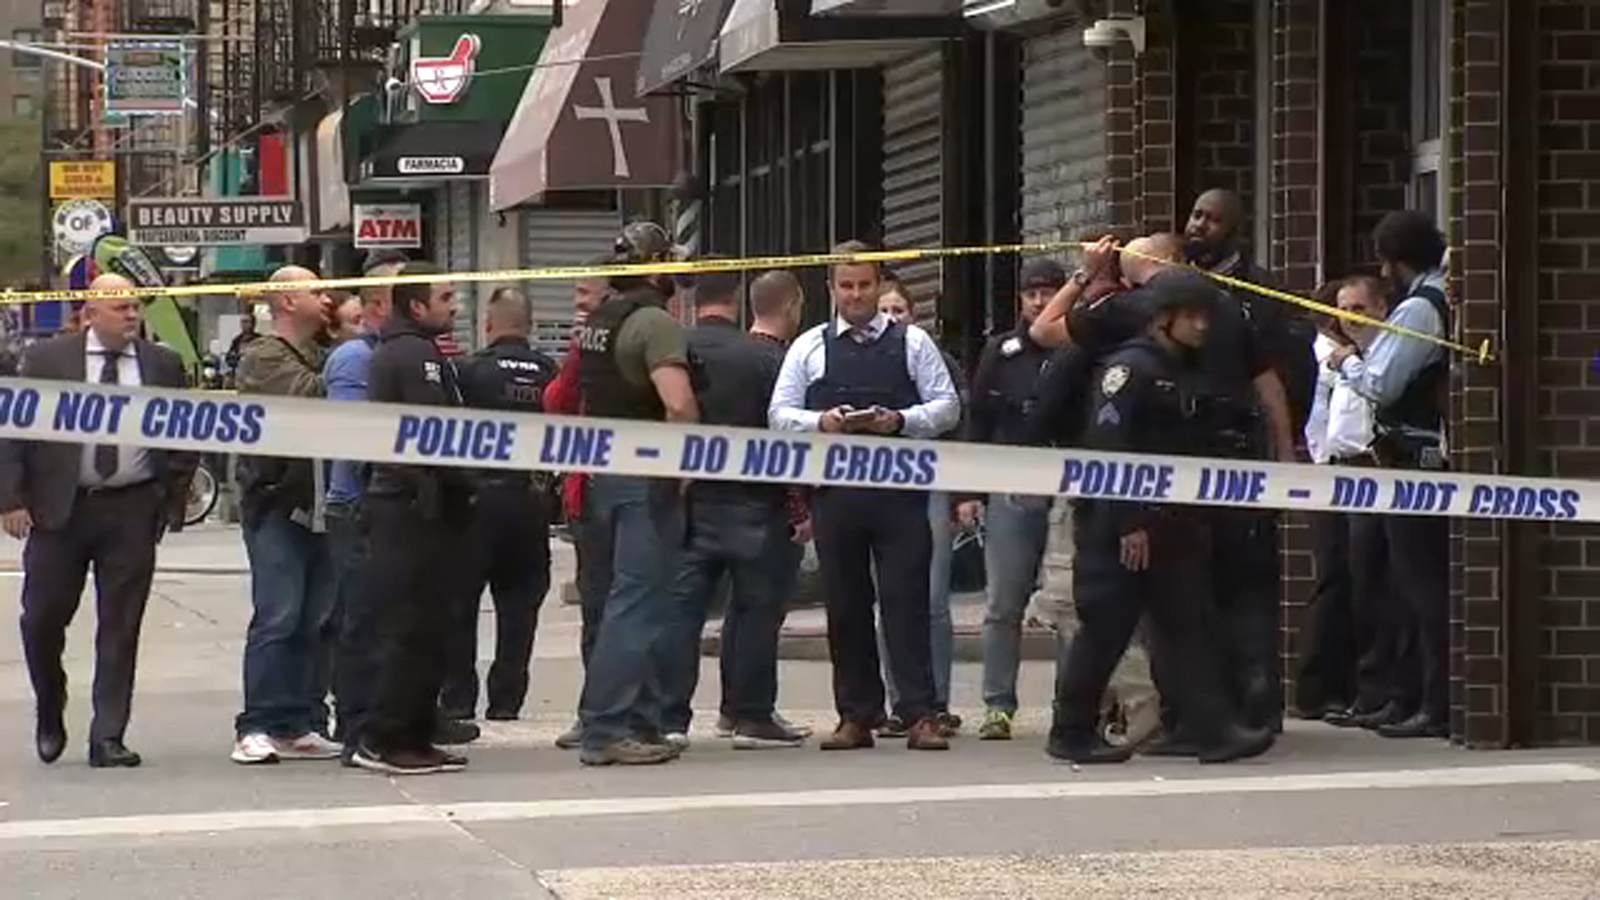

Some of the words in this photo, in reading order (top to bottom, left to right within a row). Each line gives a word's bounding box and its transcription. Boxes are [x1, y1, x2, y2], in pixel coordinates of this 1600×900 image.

[404, 159, 459, 170] FARMACIA
[138, 206, 213, 226] BEAUTY
[219, 204, 293, 224] SUPPLY
[203, 229, 246, 241] DISCOUNT
[358, 219, 418, 238] ATM
[52, 391, 131, 435] NOT
[141, 397, 266, 444] CROSS
[394, 414, 517, 461] POLICE
[539, 425, 614, 467] LINE
[679, 434, 729, 474] DO
[740, 439, 812, 478] NOT
[823, 444, 938, 486] CROSS
[1059, 459, 1174, 498] POLICE
[1197, 468, 1267, 502] LINE
[1330, 476, 1378, 508] DO
[1390, 479, 1458, 512] NOT
[1468, 484, 1581, 519] CROSS
